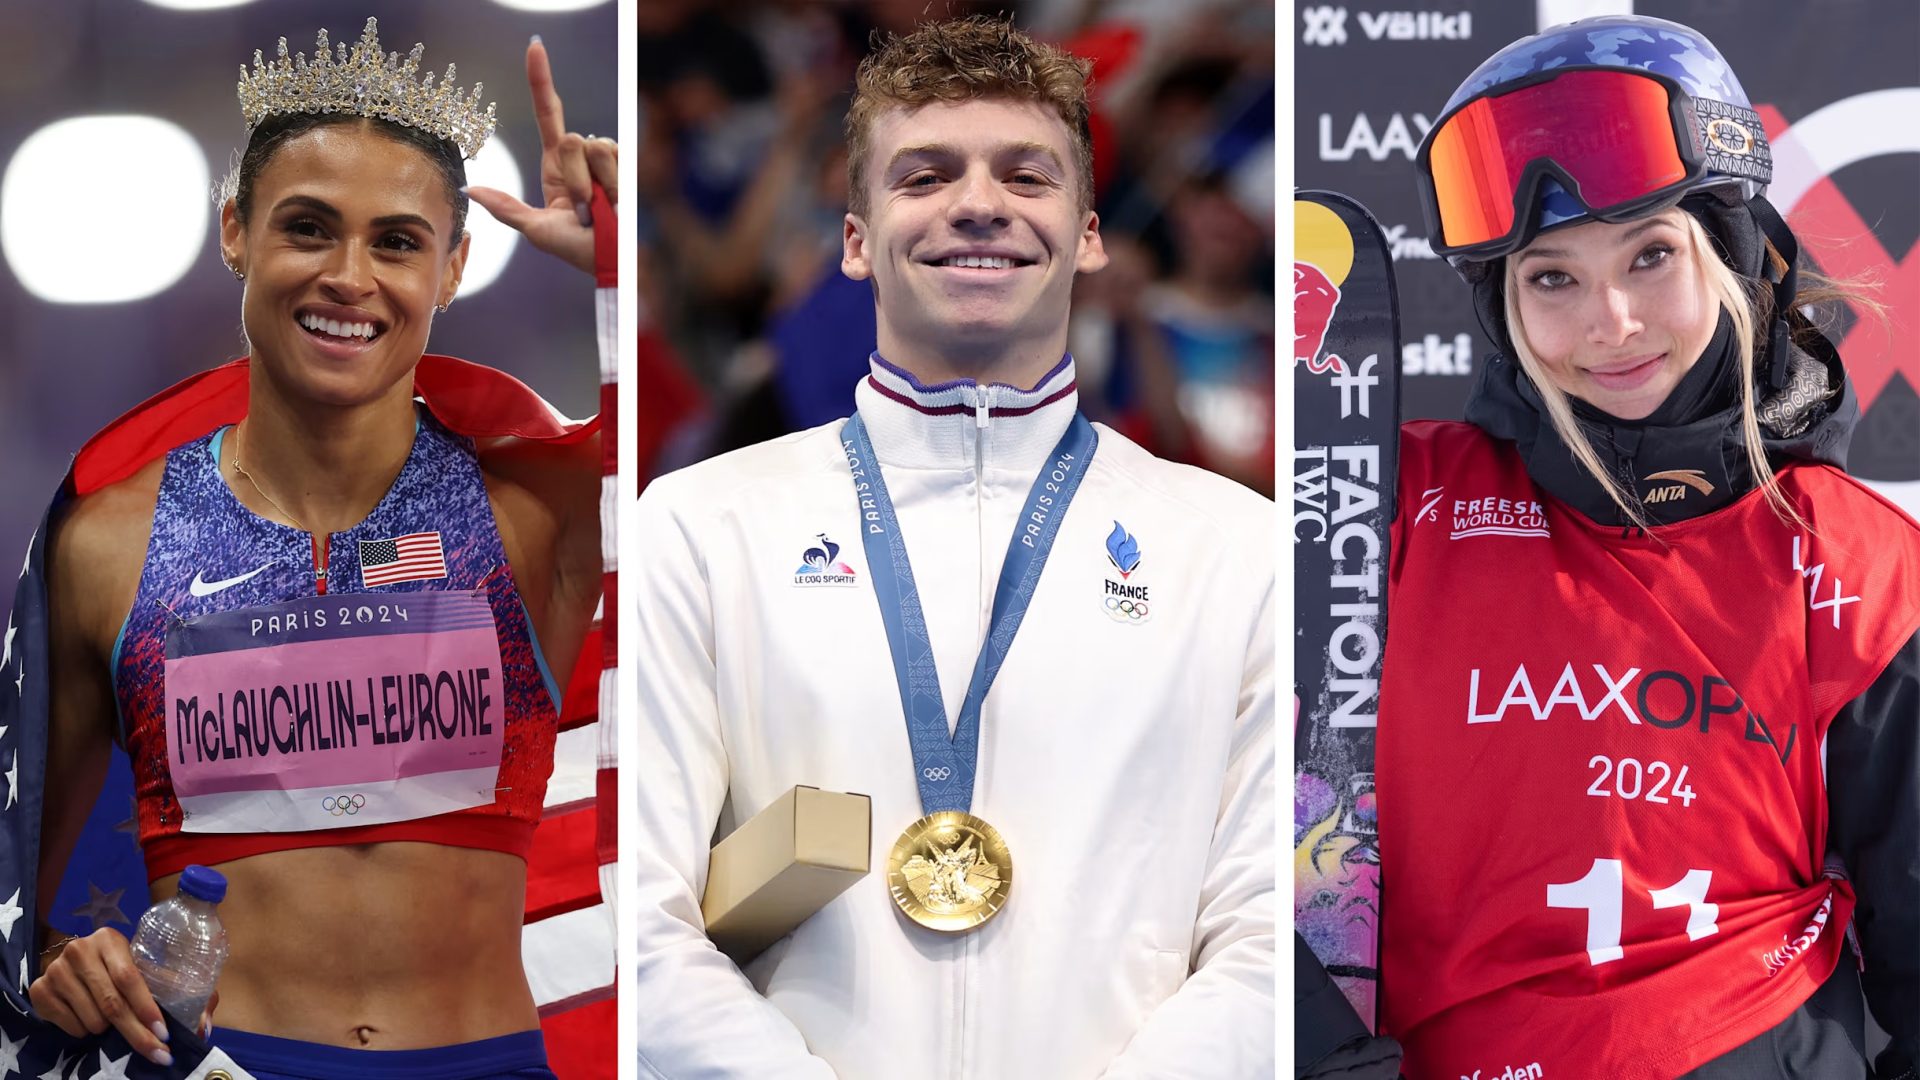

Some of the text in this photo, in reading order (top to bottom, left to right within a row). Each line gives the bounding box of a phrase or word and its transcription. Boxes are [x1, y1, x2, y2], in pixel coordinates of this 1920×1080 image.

[1046, 453, 1075, 494] 2024
[1294, 446, 1328, 544] IWC
[1643, 485, 1686, 504] ANTA
[1453, 511, 1515, 530] WORLD
[794, 574, 857, 584] LE COQ SPORTIF
[1104, 578, 1149, 601] FRANCE
[1328, 445, 1381, 728] FACTION
[338, 604, 408, 626] 2024
[175, 667, 493, 765] McLAUGHLIN-LEVRONE
[1586, 754, 1698, 808] 2024
[1546, 858, 1721, 967] 11
